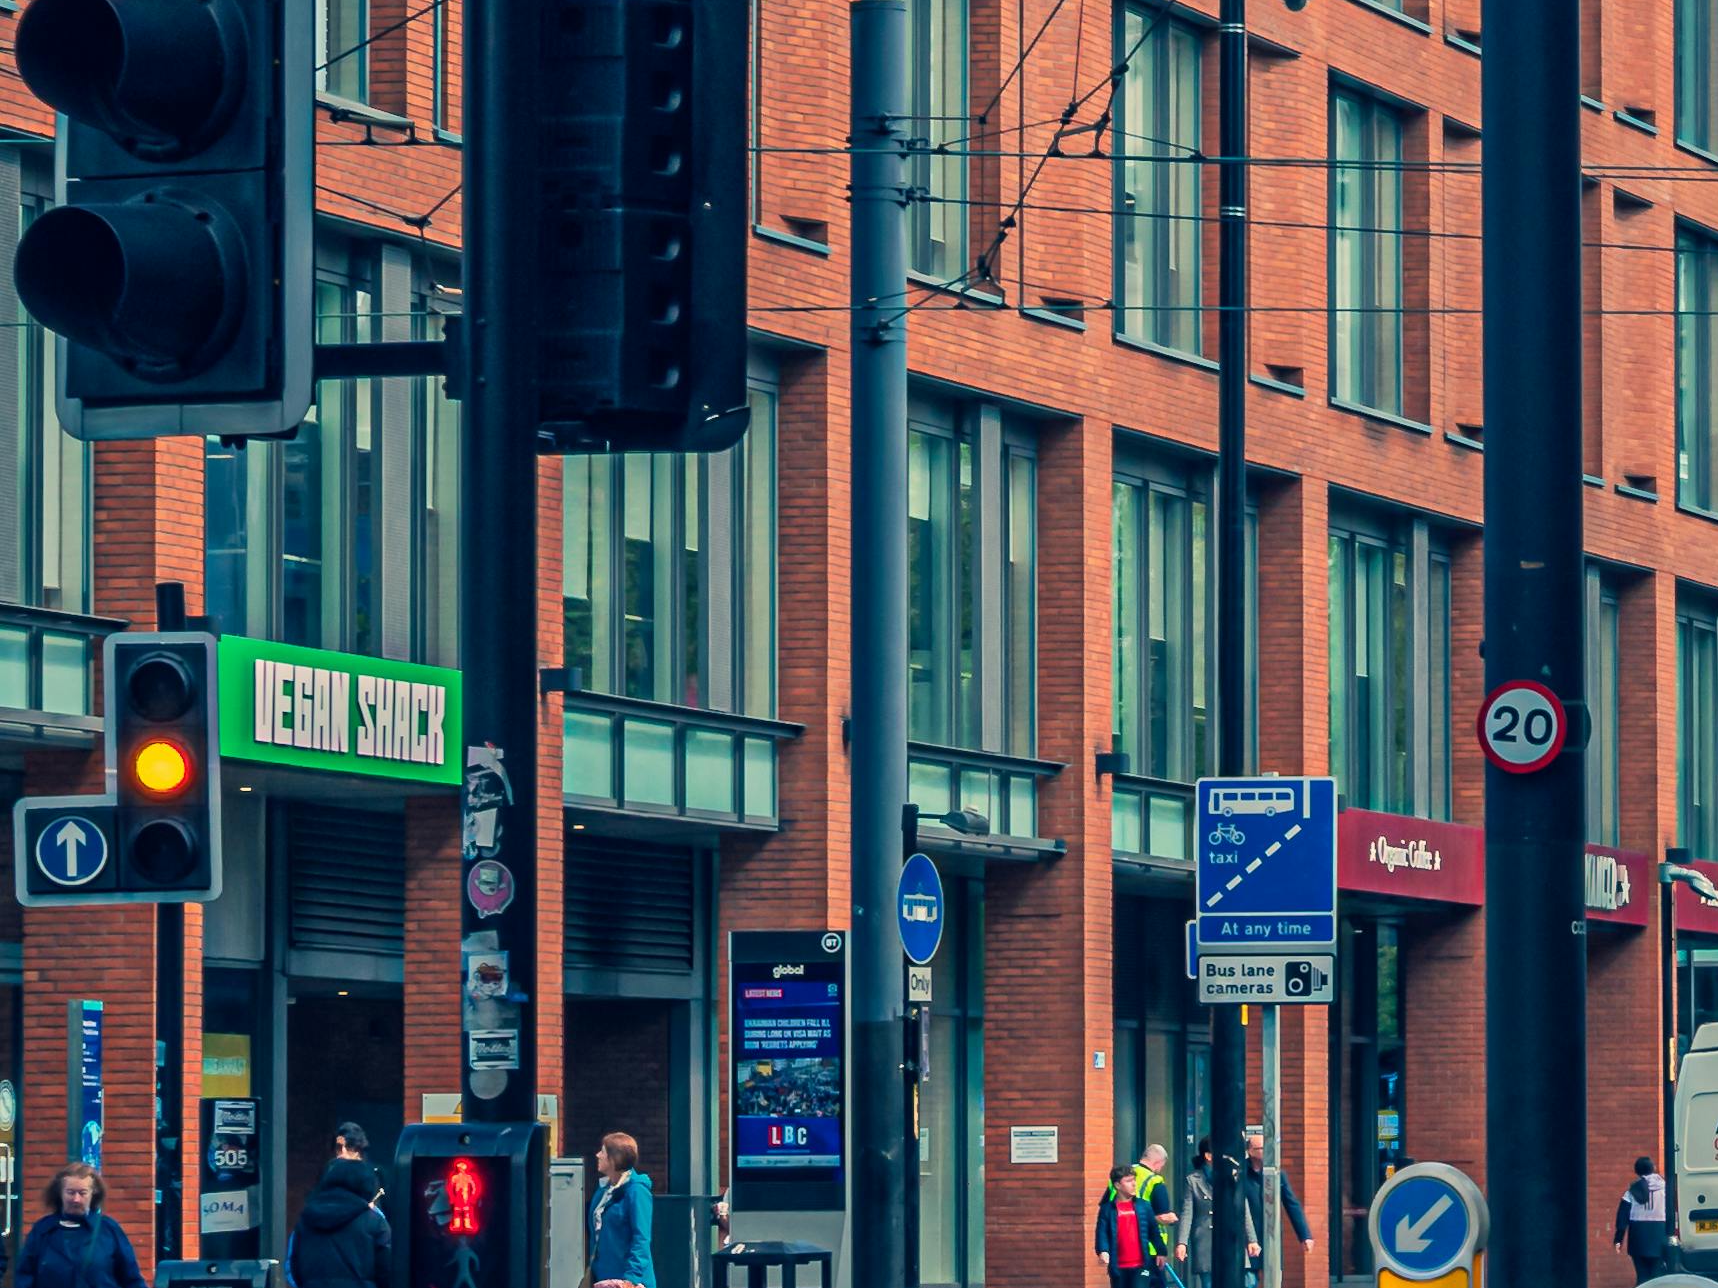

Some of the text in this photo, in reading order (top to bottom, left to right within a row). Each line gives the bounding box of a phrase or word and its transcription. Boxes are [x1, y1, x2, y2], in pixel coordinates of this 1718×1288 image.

[255, 658, 446, 765] VEGAN SHACK
[1493, 705, 1553, 746] 20
[1209, 851, 1238, 864] taxi
[1378, 836, 1433, 872] Organic Coffee
[1221, 921, 1312, 937] At any time
[773, 964, 804, 978] global
[1206, 962, 1275, 978] Bus lane
[911, 973, 931, 995] Only
[1206, 982, 1274, 995] cameras
[771, 1125, 807, 1145] LBC
[214, 1149, 249, 1166] 505
